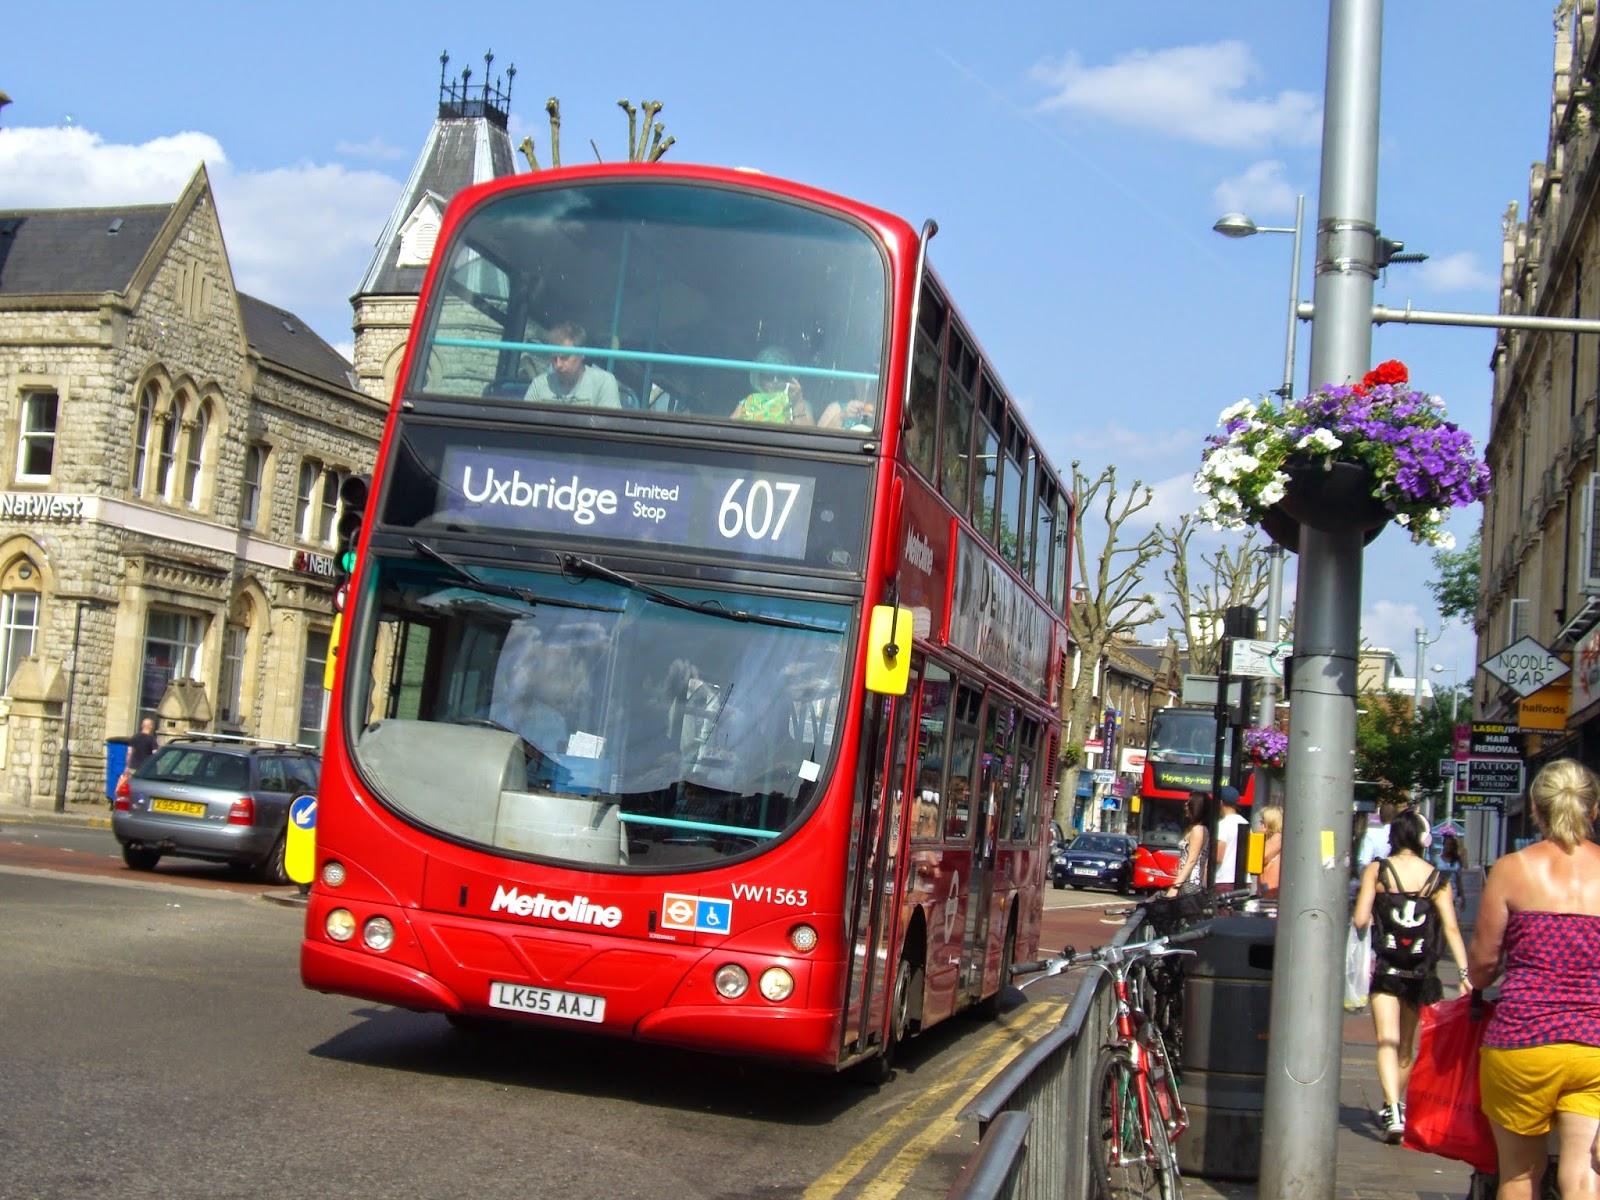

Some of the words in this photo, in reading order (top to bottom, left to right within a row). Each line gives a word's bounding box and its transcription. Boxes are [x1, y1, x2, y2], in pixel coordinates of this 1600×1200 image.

[462, 466, 618, 526] Uxbridge
[624, 480, 679, 503] Limited
[0, 494, 82, 519] NatWest
[632, 504, 667, 523] Stop
[717, 478, 801, 541] 607
[905, 521, 934, 577] Metroline
[309, 553, 336, 578] NatW
[1499, 654, 1556, 671] NOODLE
[1507, 669, 1545, 686] BAR
[1522, 703, 1566, 714] halfords
[1474, 744, 1519, 753] REMOVAL
[1486, 735, 1509, 743] HAIR
[1471, 762, 1518, 771] TATTOO
[1162, 773, 1183, 783] Hayes
[183, 803, 202, 814] AEX
[1455, 795, 1483, 803] LASER
[731, 883, 808, 907] VW1563
[490, 885, 622, 928] Metroline
[498, 985, 551, 1011] LK55
[557, 997, 597, 1018] AAJ
